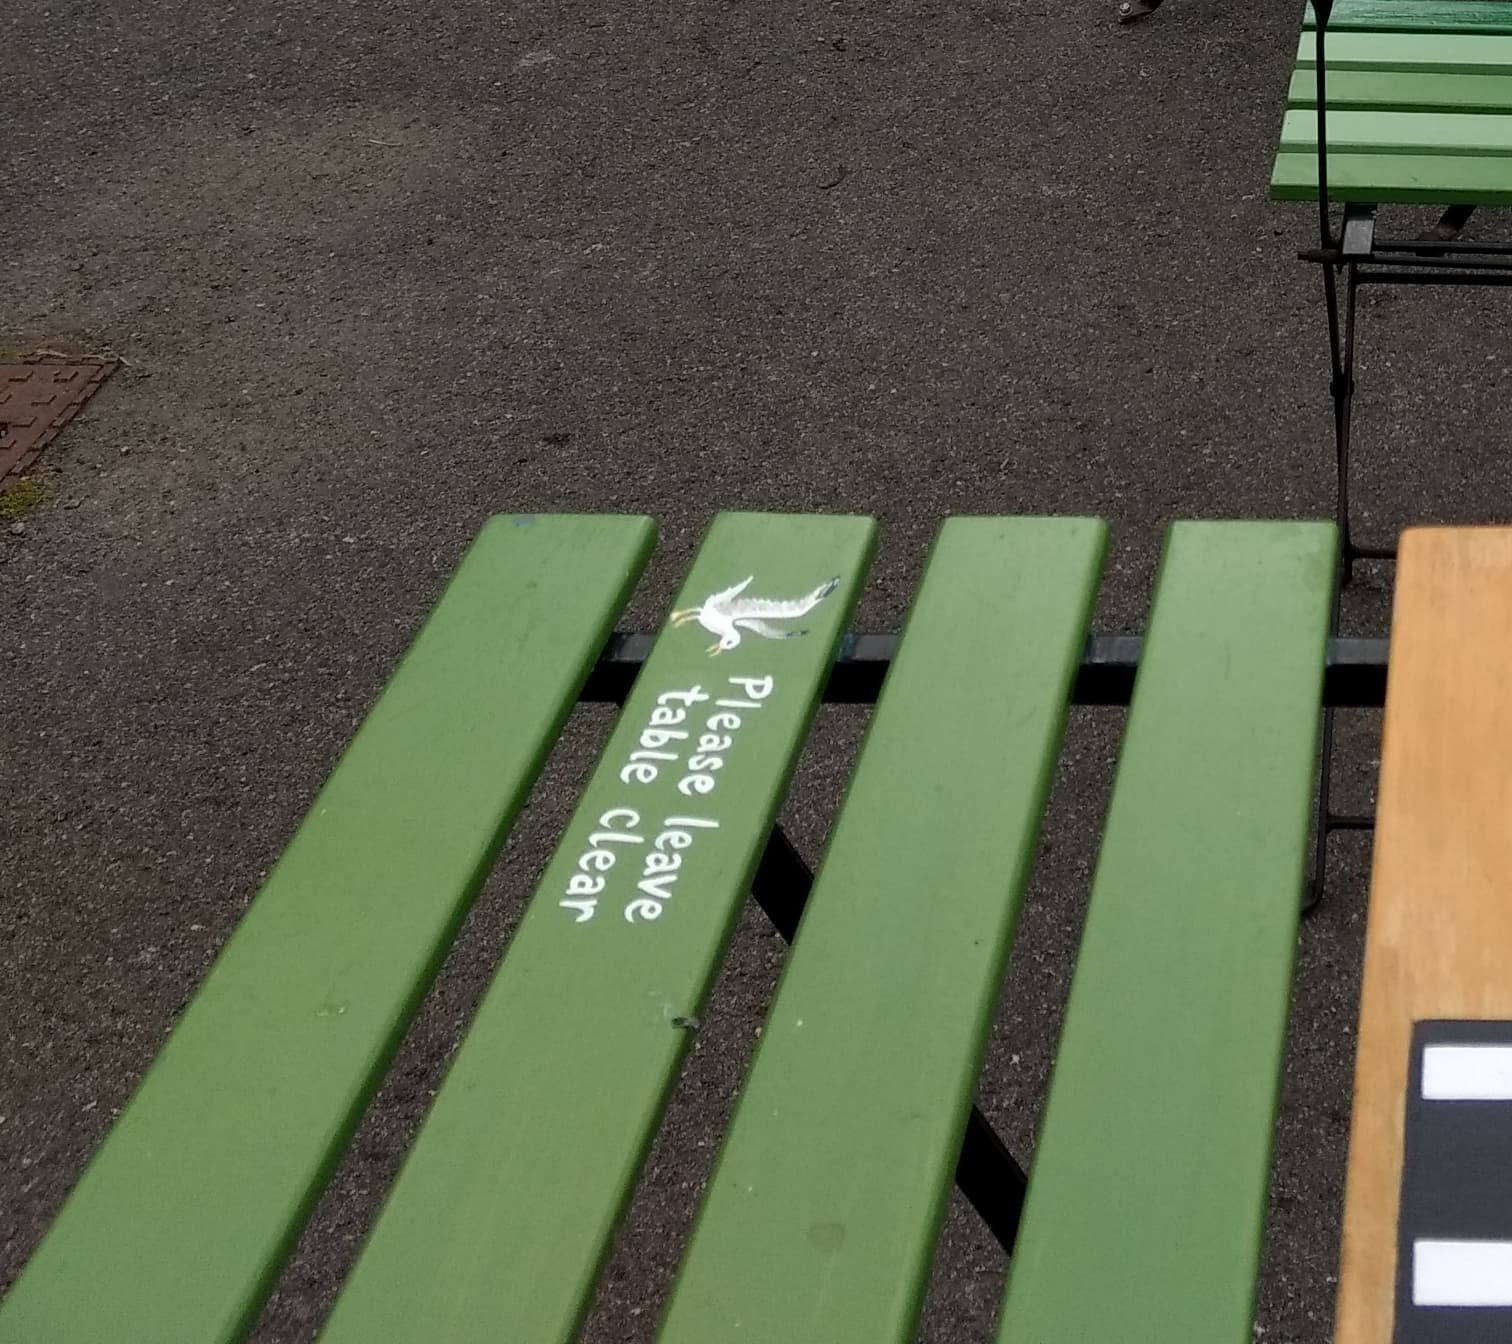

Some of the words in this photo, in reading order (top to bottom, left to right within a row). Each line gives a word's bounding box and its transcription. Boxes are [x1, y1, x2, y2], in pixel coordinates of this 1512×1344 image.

[619, 685, 710, 785] table
[678, 675, 774, 796] Please
[559, 808, 645, 924] clear
[624, 816, 720, 923] leave
